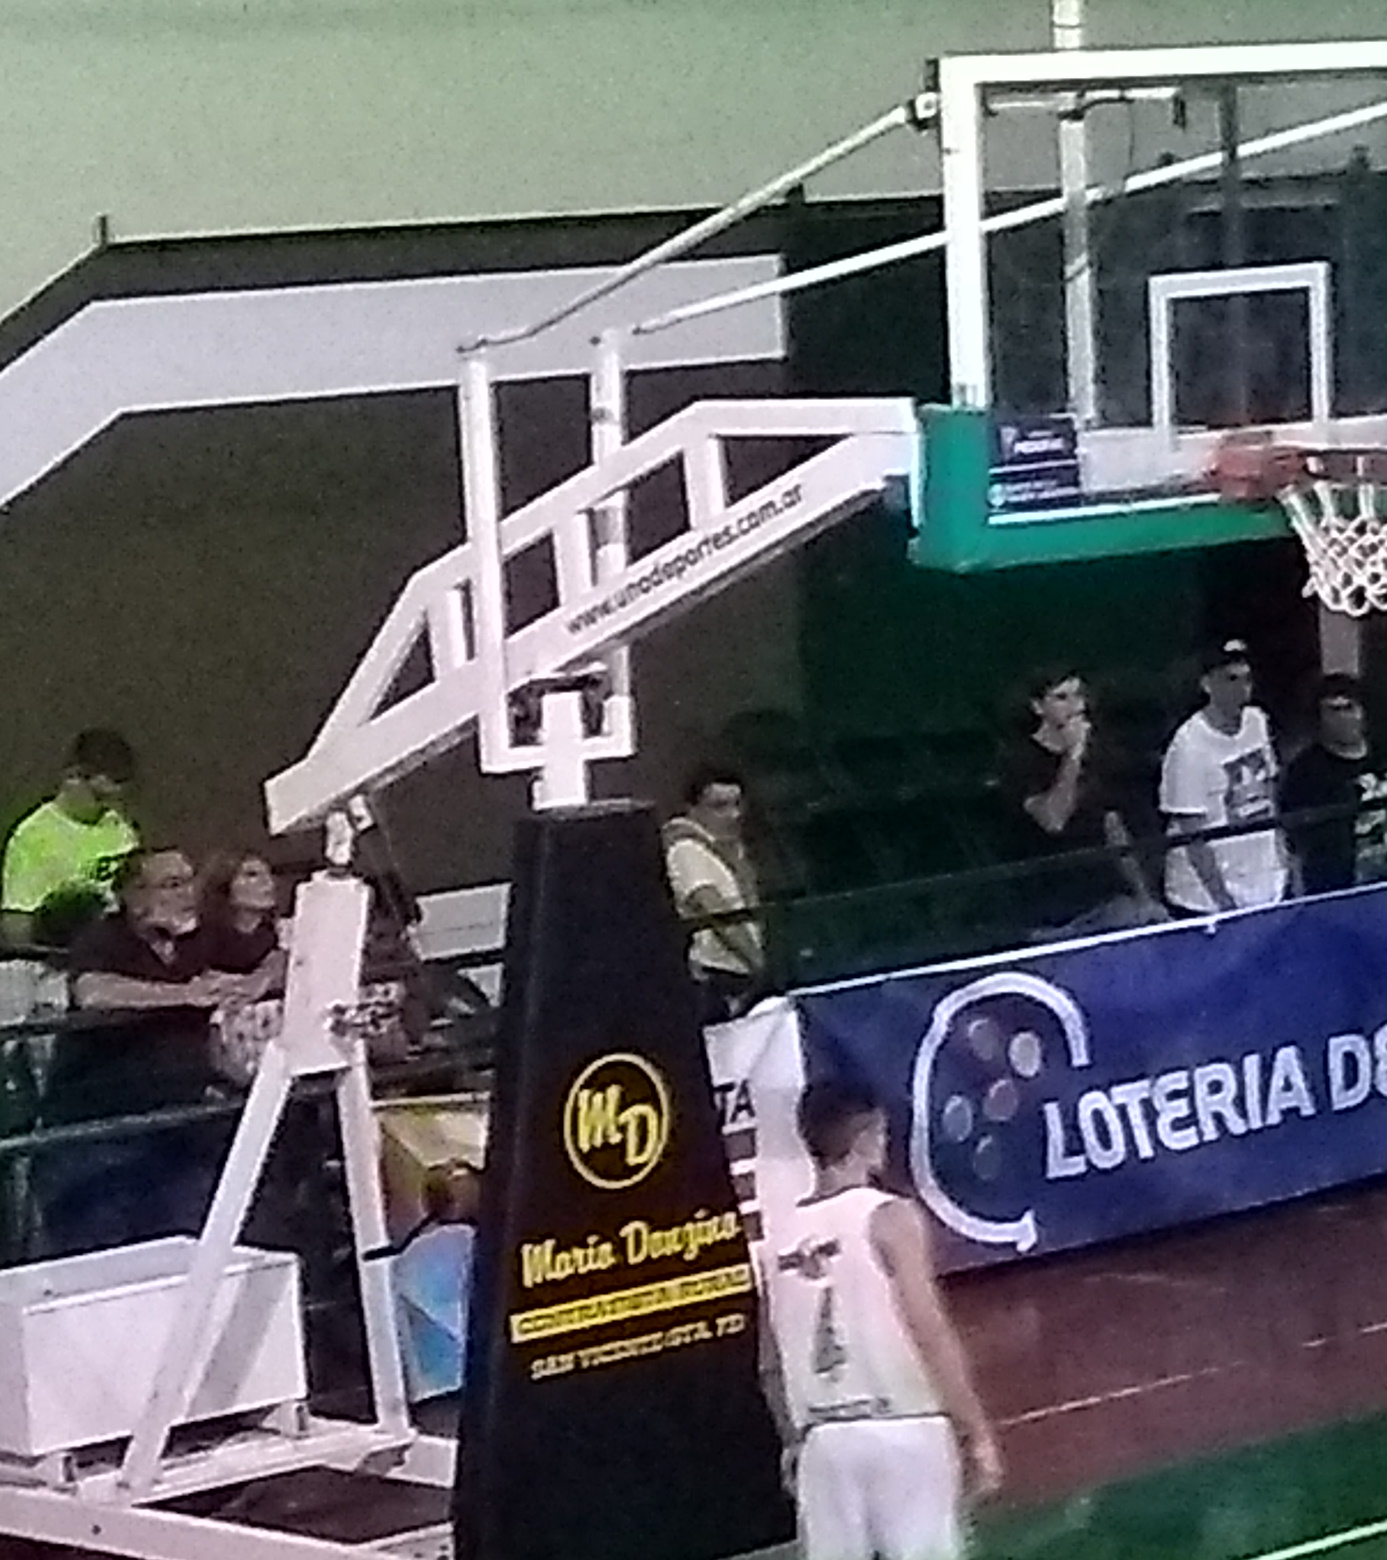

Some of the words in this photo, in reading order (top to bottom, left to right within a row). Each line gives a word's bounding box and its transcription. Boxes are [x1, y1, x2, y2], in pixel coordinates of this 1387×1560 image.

[577, 1083, 659, 1168] MD
[1043, 1044, 1316, 1180] LOTERIA
[522, 1234, 616, 1288] Mario
